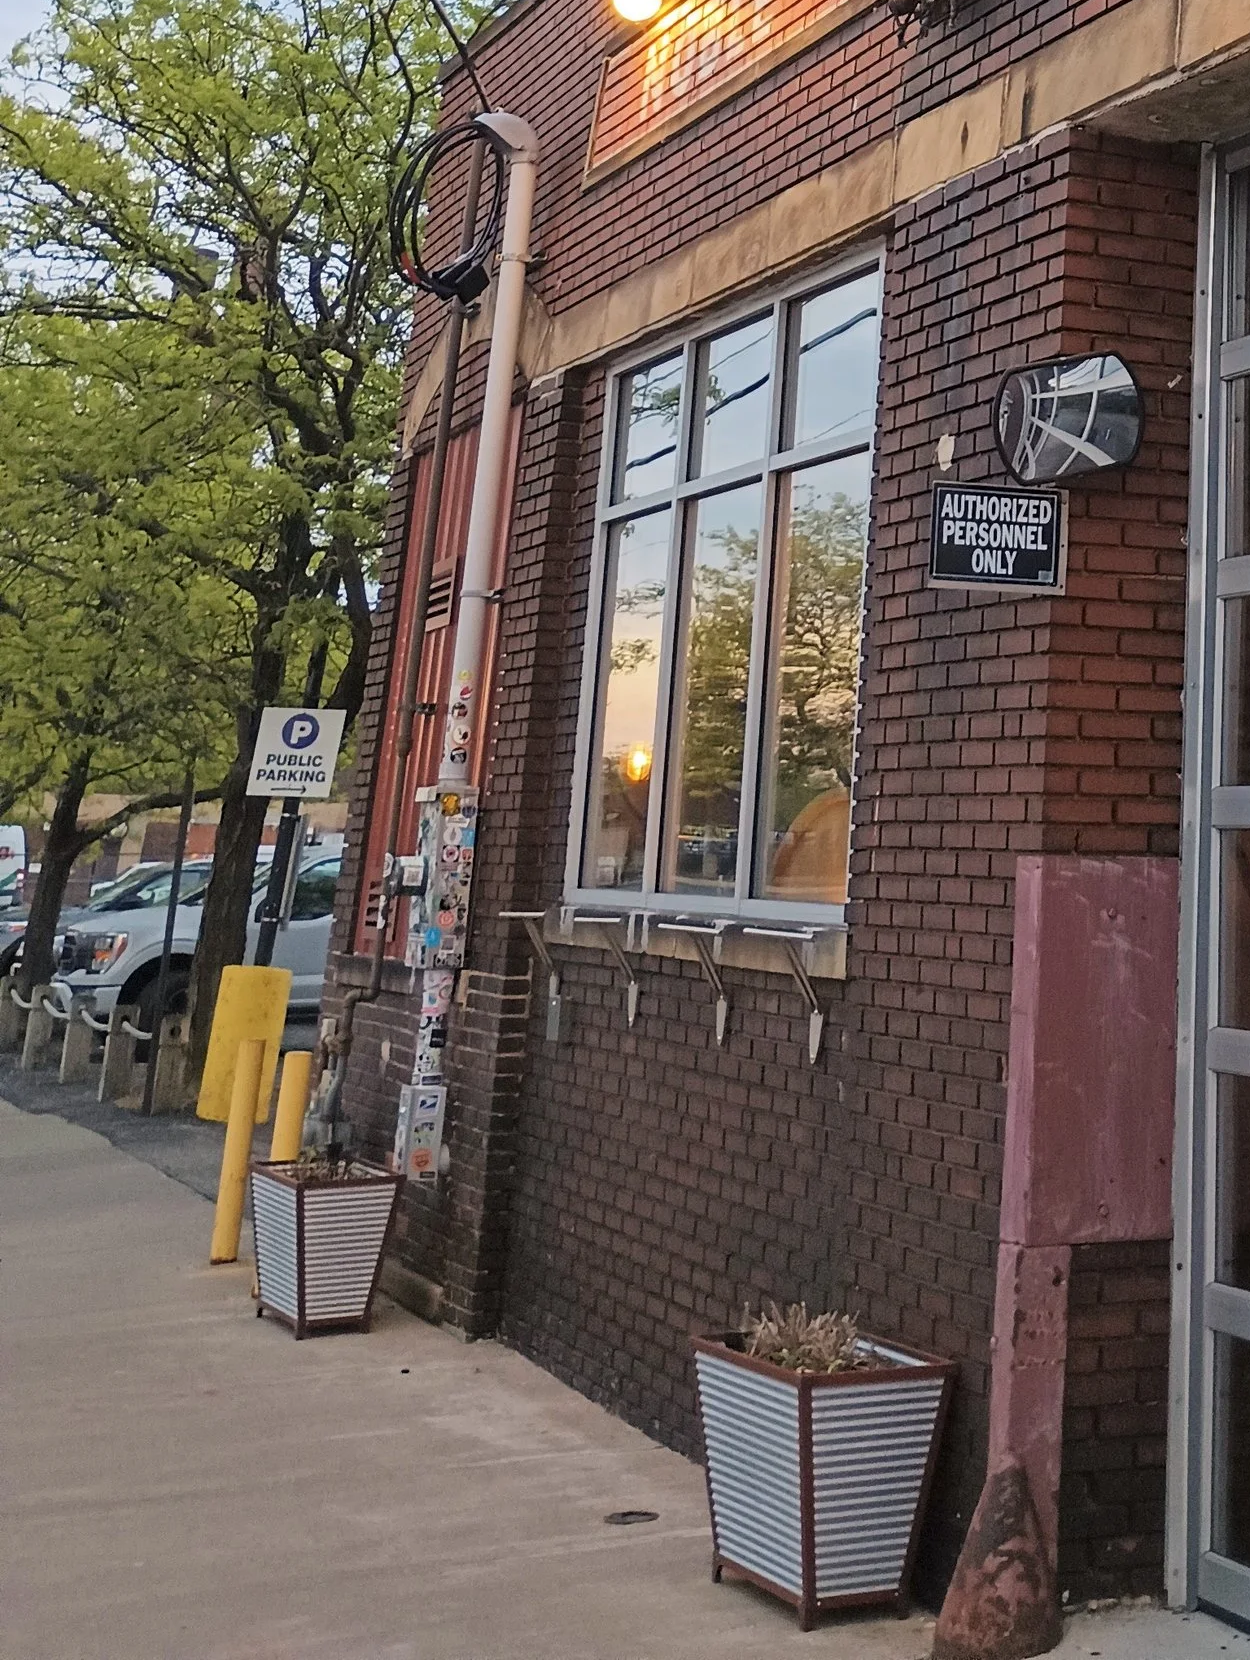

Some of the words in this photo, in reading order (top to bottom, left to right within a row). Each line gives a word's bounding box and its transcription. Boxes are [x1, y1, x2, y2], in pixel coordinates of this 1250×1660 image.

[941, 493, 1052, 524] AUTHORIZED
[942, 519, 1048, 551] PERSONNEL
[971, 548, 1017, 575] ONLY
[290, 720, 313, 744] P
[266, 753, 323, 767] PUBLIC
[256, 768, 326, 783] PARKING
